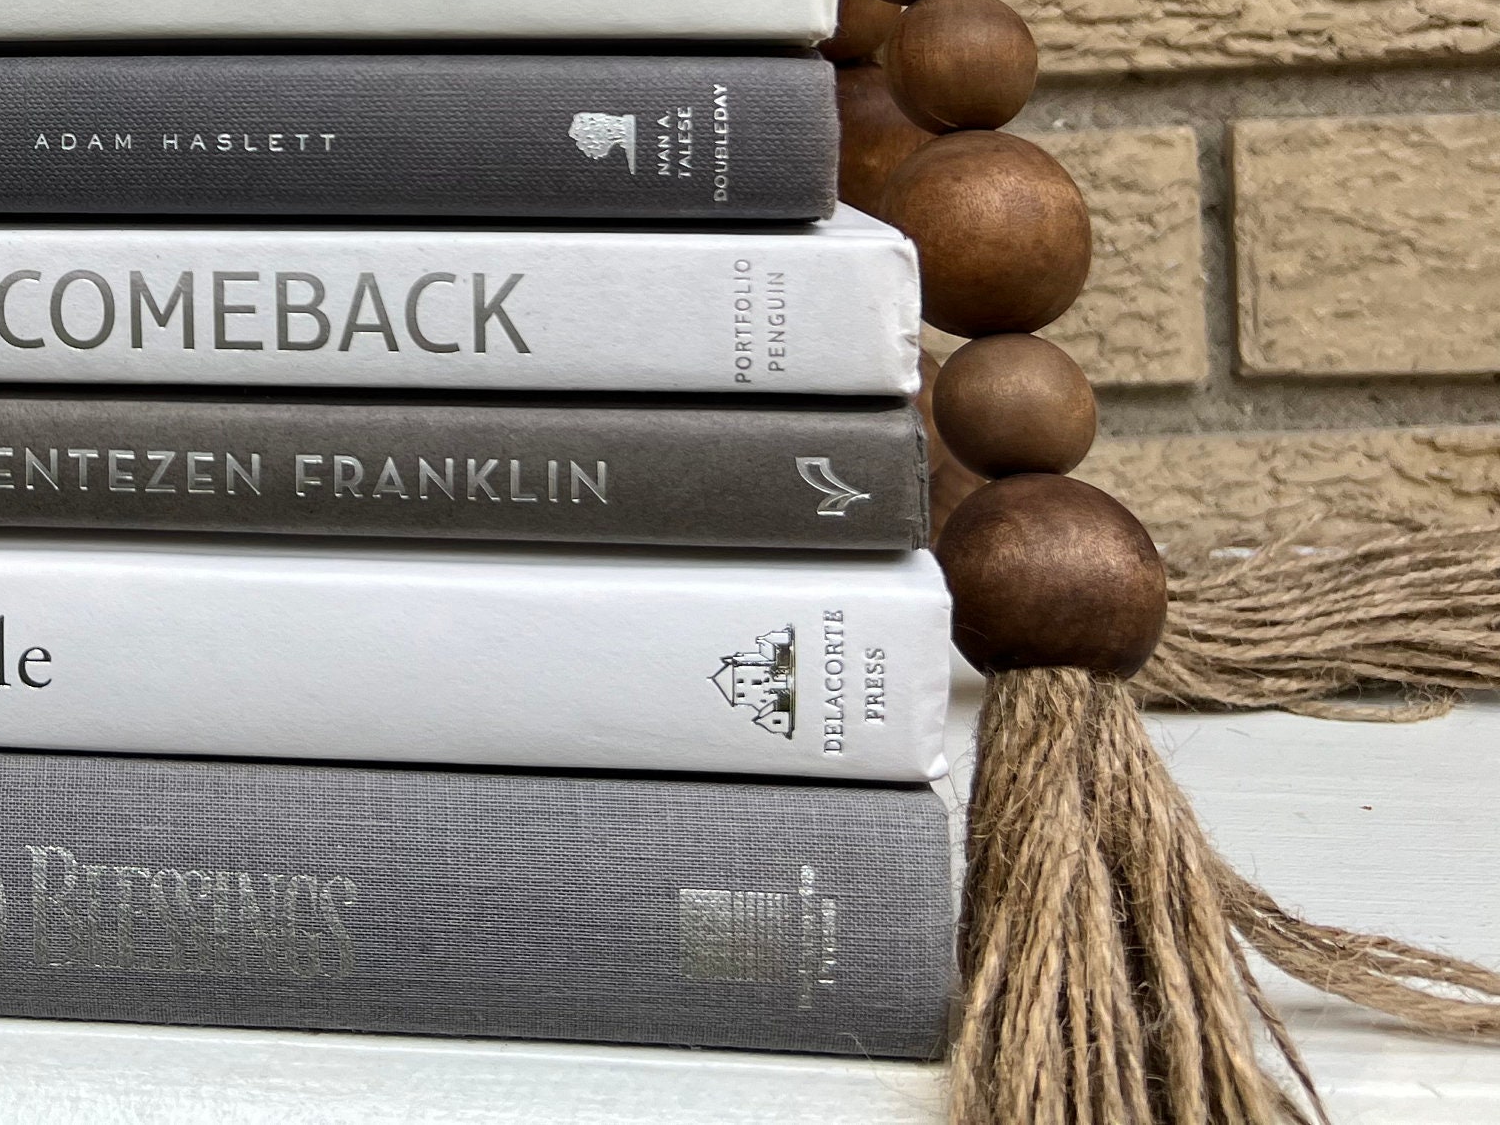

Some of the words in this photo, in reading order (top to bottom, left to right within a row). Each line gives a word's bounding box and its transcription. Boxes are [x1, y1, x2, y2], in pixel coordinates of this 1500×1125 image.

[34, 134, 134, 152] ADAM
[162, 132, 338, 153] HASLETT
[657, 135, 671, 176] NAN
[678, 105, 693, 179] TALESE
[711, 83, 729, 203] DOUBLEDAY
[734, 259, 754, 385] PORTFOLIO
[767, 271, 786, 373] PENGUIN
[294, 455, 610, 507] FRANKLIN
[823, 608, 845, 755] DELACORTE
[864, 646, 886, 724] PRESS
